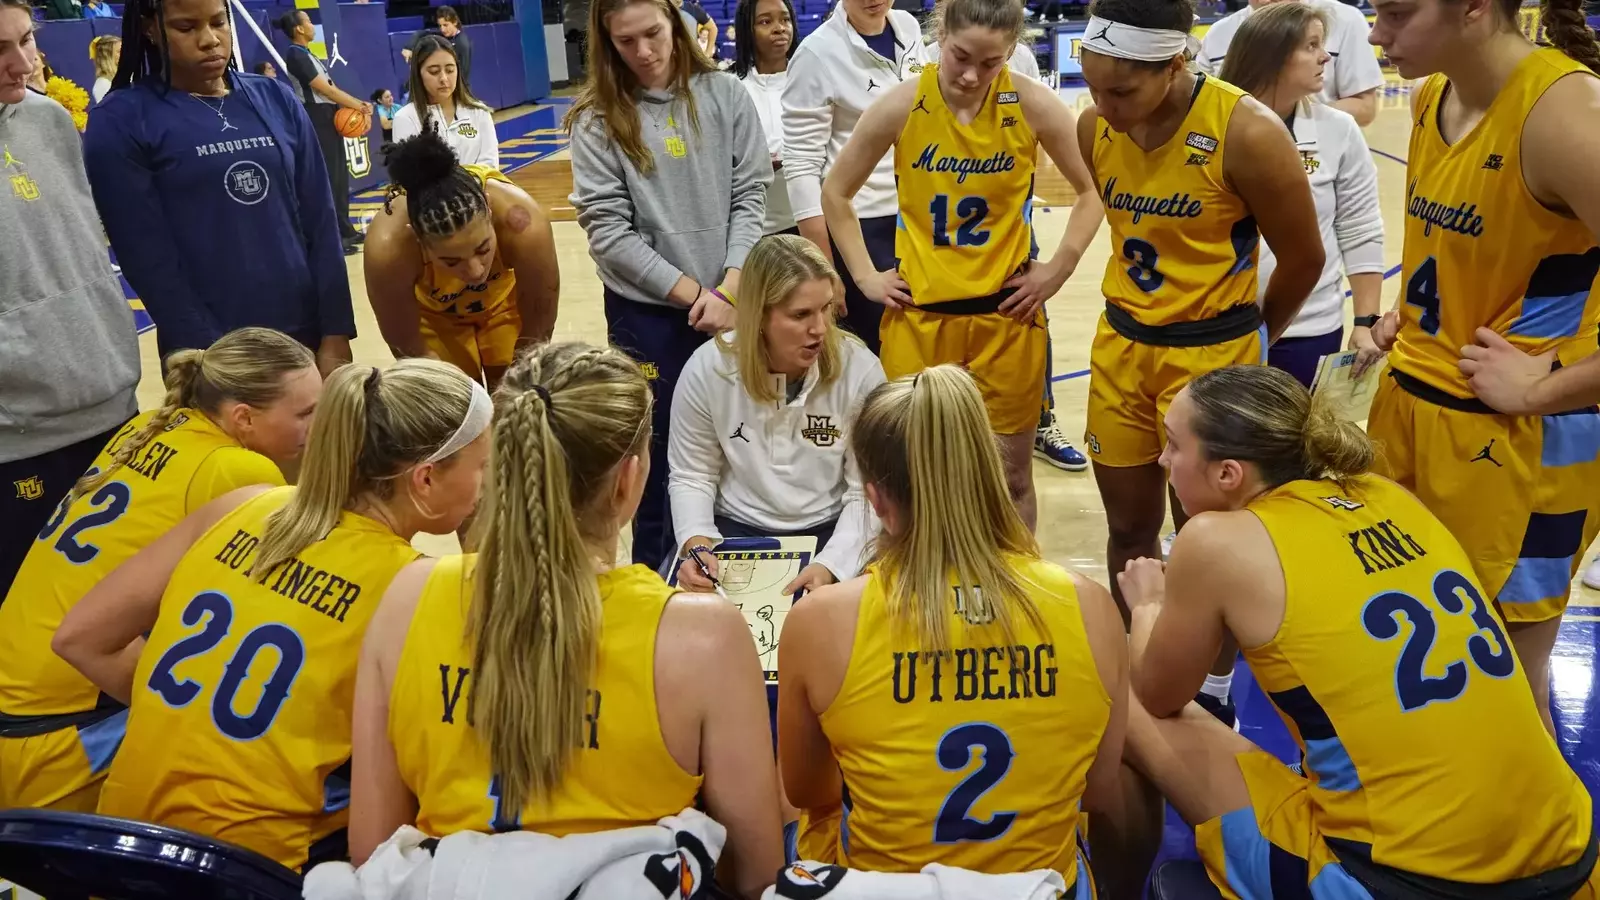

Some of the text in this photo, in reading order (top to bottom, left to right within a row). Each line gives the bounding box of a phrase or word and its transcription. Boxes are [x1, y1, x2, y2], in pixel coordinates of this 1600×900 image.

[196, 136, 275, 156] MARQUETTE
[912, 143, 1015, 184] Marquette
[8, 172, 41, 201] MU
[231, 169, 262, 195] MU
[1103, 176, 1203, 225] Marquette
[930, 193, 991, 247] 12
[1121, 236, 1164, 293] 3
[1406, 255, 1441, 337] 4
[13, 475, 45, 500] MU
[717, 552, 800, 560] RQUETTE
[1346, 519, 1428, 575] KING
[214, 529, 361, 623] HOTINGER
[147, 590, 306, 741] 20
[1361, 569, 1515, 713] 23
[892, 643, 1059, 704] UTBERG
[933, 721, 1018, 845] 2
